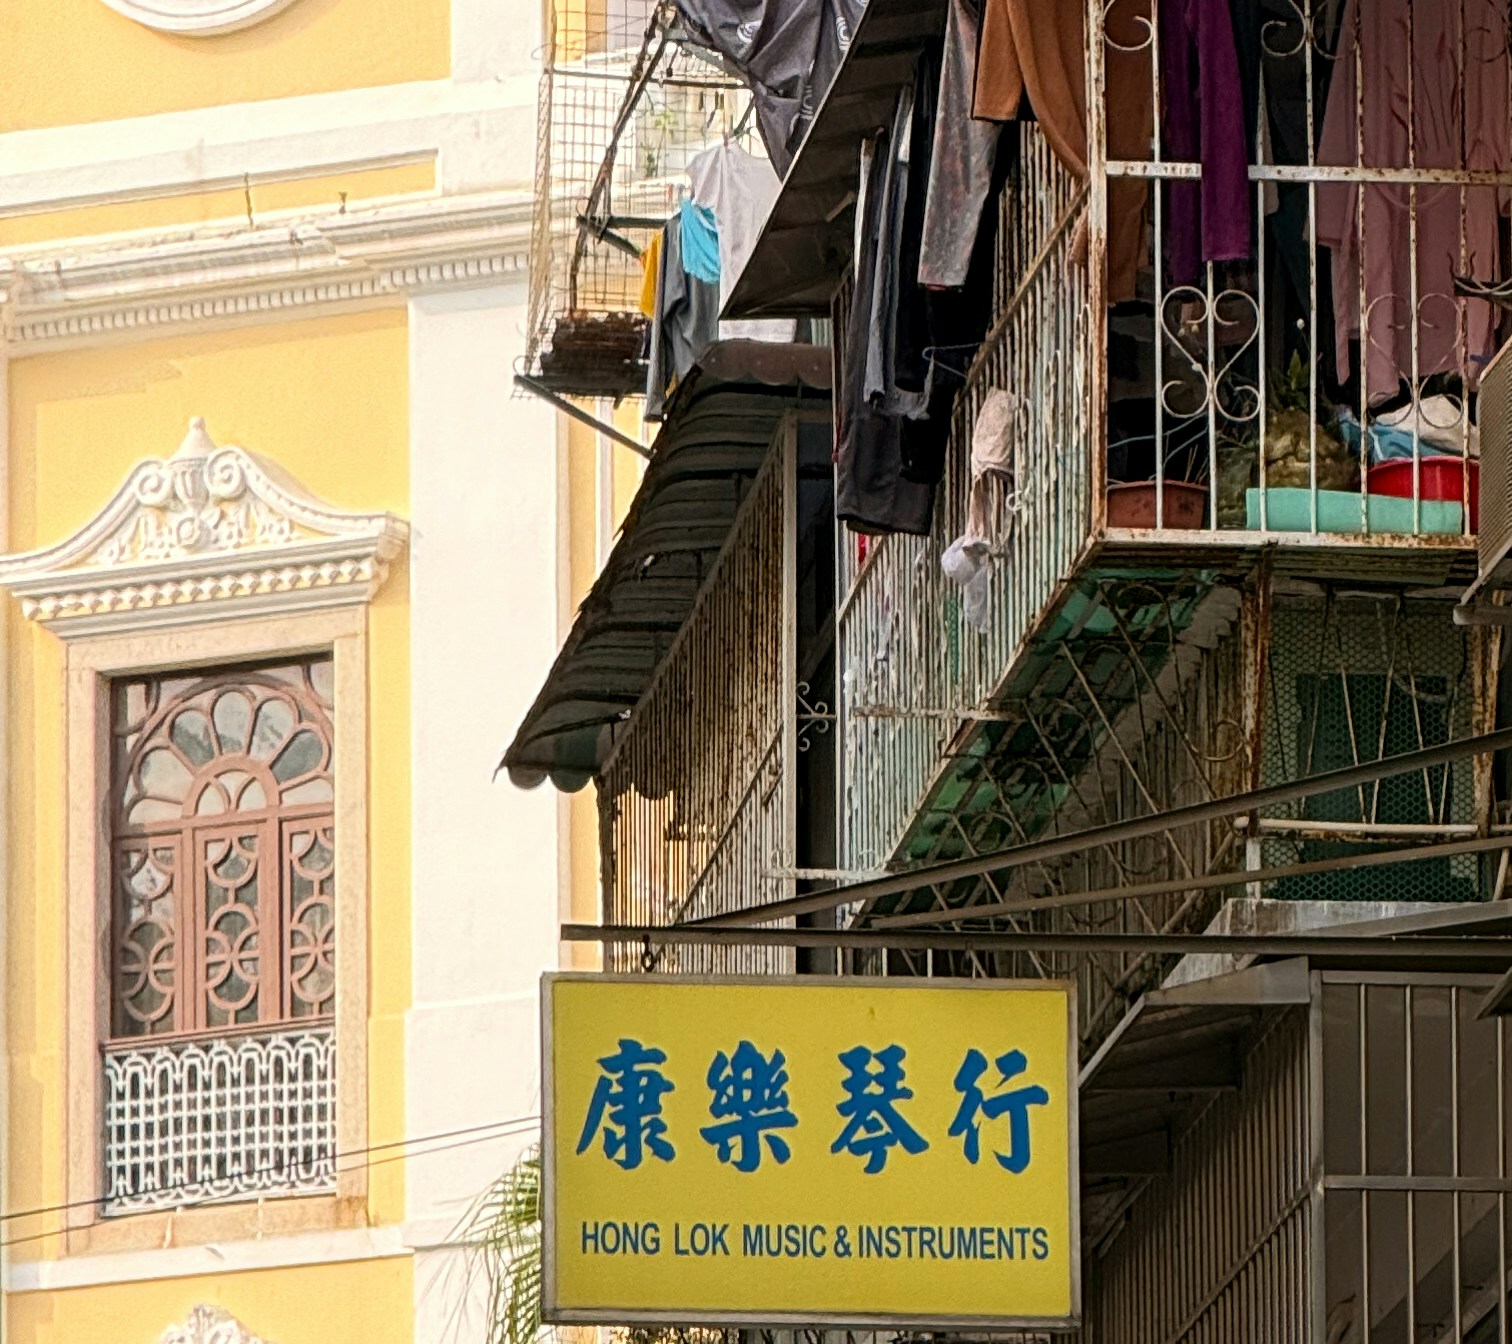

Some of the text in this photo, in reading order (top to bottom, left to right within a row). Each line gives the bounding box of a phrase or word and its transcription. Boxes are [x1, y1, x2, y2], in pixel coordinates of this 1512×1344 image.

[576, 1038, 1050, 1175] 康樂琴行
[581, 1220, 1049, 1261] HONG LOK MUSIC & INSTRUMENTS
